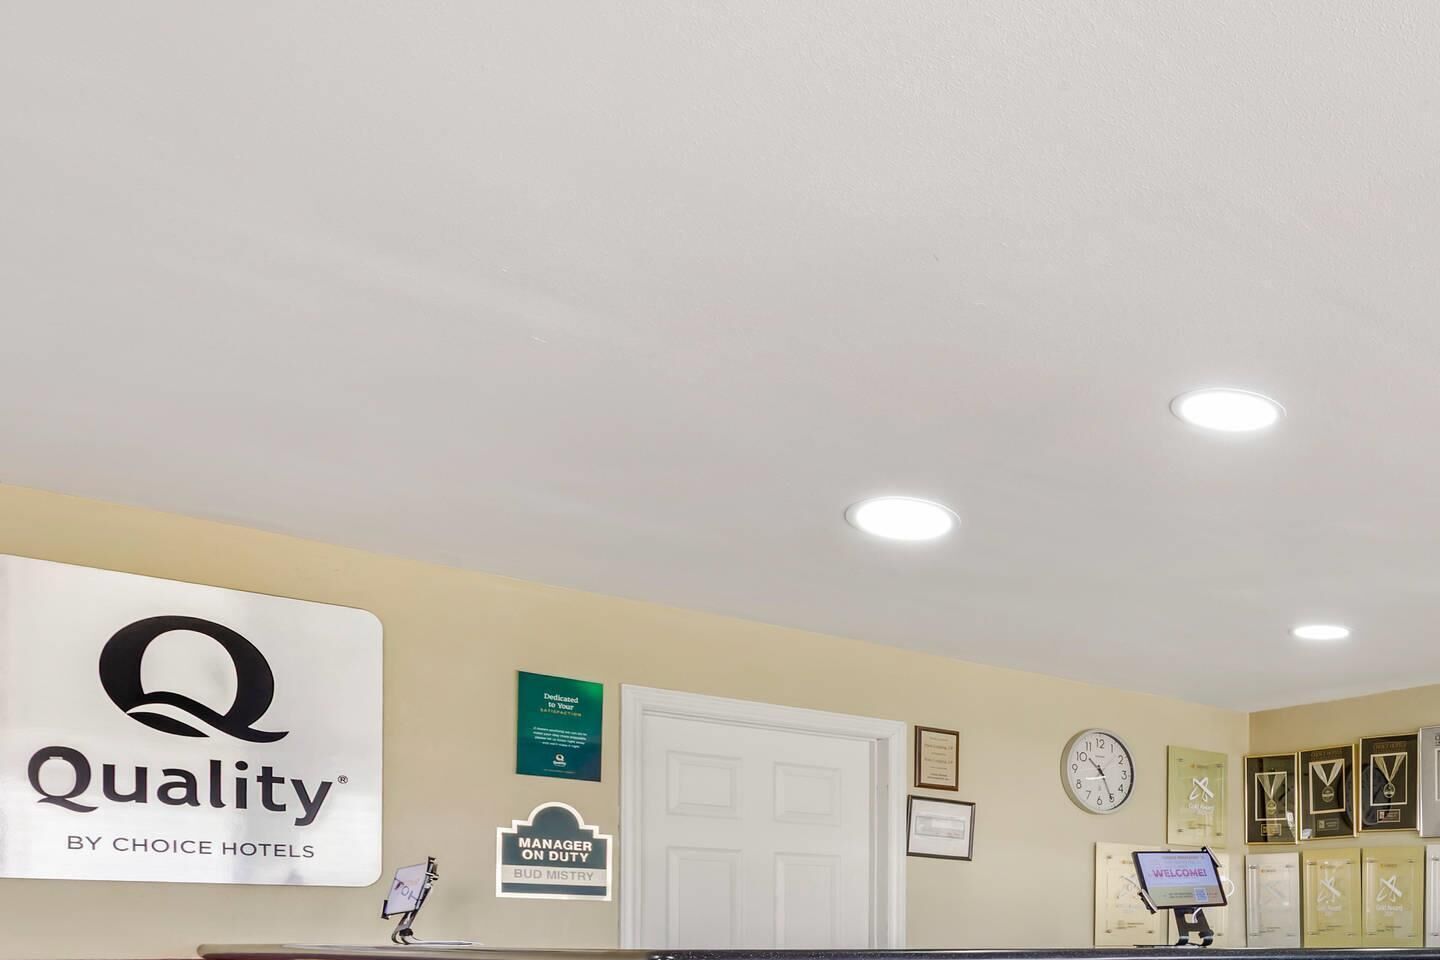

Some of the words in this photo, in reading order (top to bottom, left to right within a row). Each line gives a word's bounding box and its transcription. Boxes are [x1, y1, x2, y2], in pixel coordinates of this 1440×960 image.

[544, 693, 578, 703] Dedicated
[558, 702, 574, 710] Your
[1086, 742, 1091, 752] 11
[1096, 738, 1104, 749] 12
[1077, 752, 1087, 761] 10
[1119, 755, 1123, 764] 2
[1072, 764, 1078, 773] 9
[1122, 771, 1127, 780] 3
[28, 745, 332, 826] Quality
[1076, 779, 1081, 789] 8
[1119, 784, 1123, 792] 4
[1086, 790, 1091, 799] 7
[1109, 793, 1114, 802] 5
[1097, 796, 1102, 805] 6
[66, 835, 102, 851] BY
[113, 837, 212, 855] CHOICE
[222, 842, 314, 858] HOTELS
[519, 838, 592, 851] MANAGER
[522, 850, 544, 860] ON
[549, 851, 589, 862] DUTY
[514, 869, 542, 878] BUD
[547, 871, 594, 880] MISTRY
[1152, 869, 1208, 877] WELCOME!
